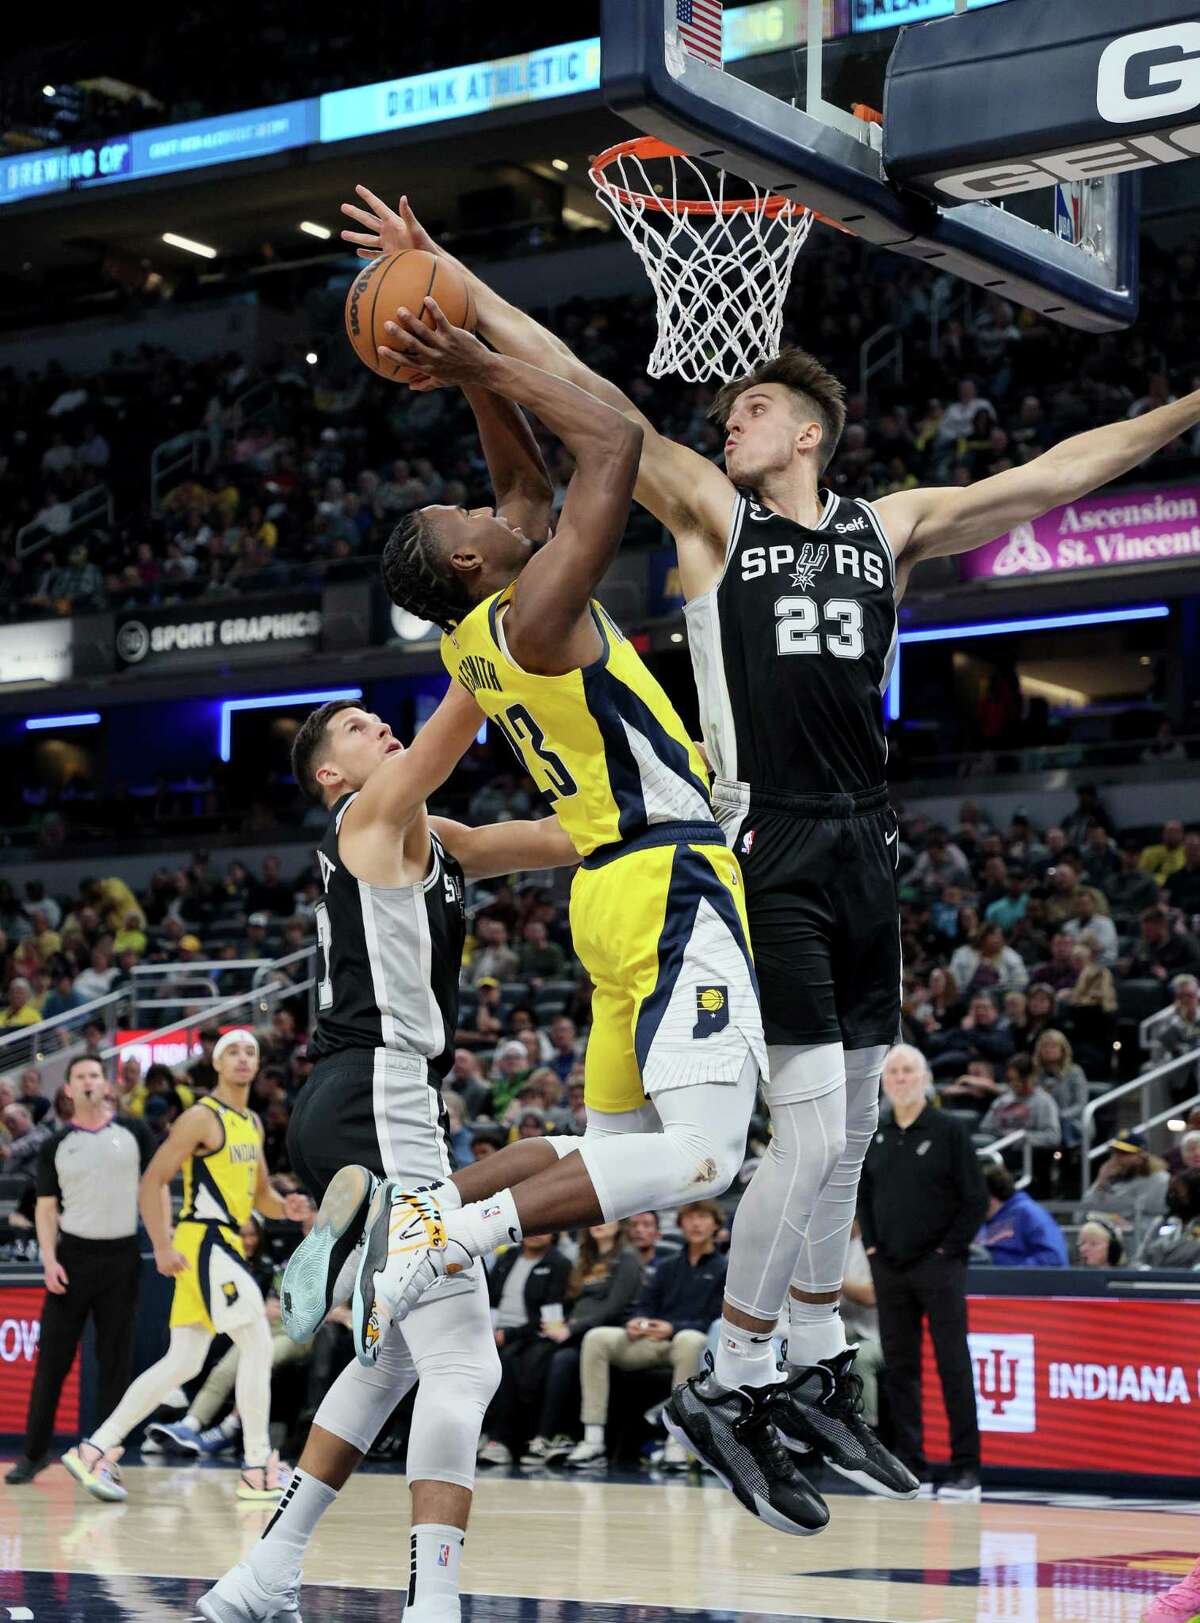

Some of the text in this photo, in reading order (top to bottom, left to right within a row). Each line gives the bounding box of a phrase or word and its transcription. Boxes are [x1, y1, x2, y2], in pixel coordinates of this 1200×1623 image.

[388, 79, 457, 117] DRINK
[467, 52, 578, 101] ATHLETIC
[1058, 495, 1198, 534] Ascension
[741, 543, 884, 591] SPURS
[1057, 525, 1200, 568] St. Vincent
[151, 621, 215, 652] SPORT
[220, 610, 322, 646] GRAPHICS
[774, 595, 866, 660] 23
[1048, 1362, 1192, 1404] INDIANA
